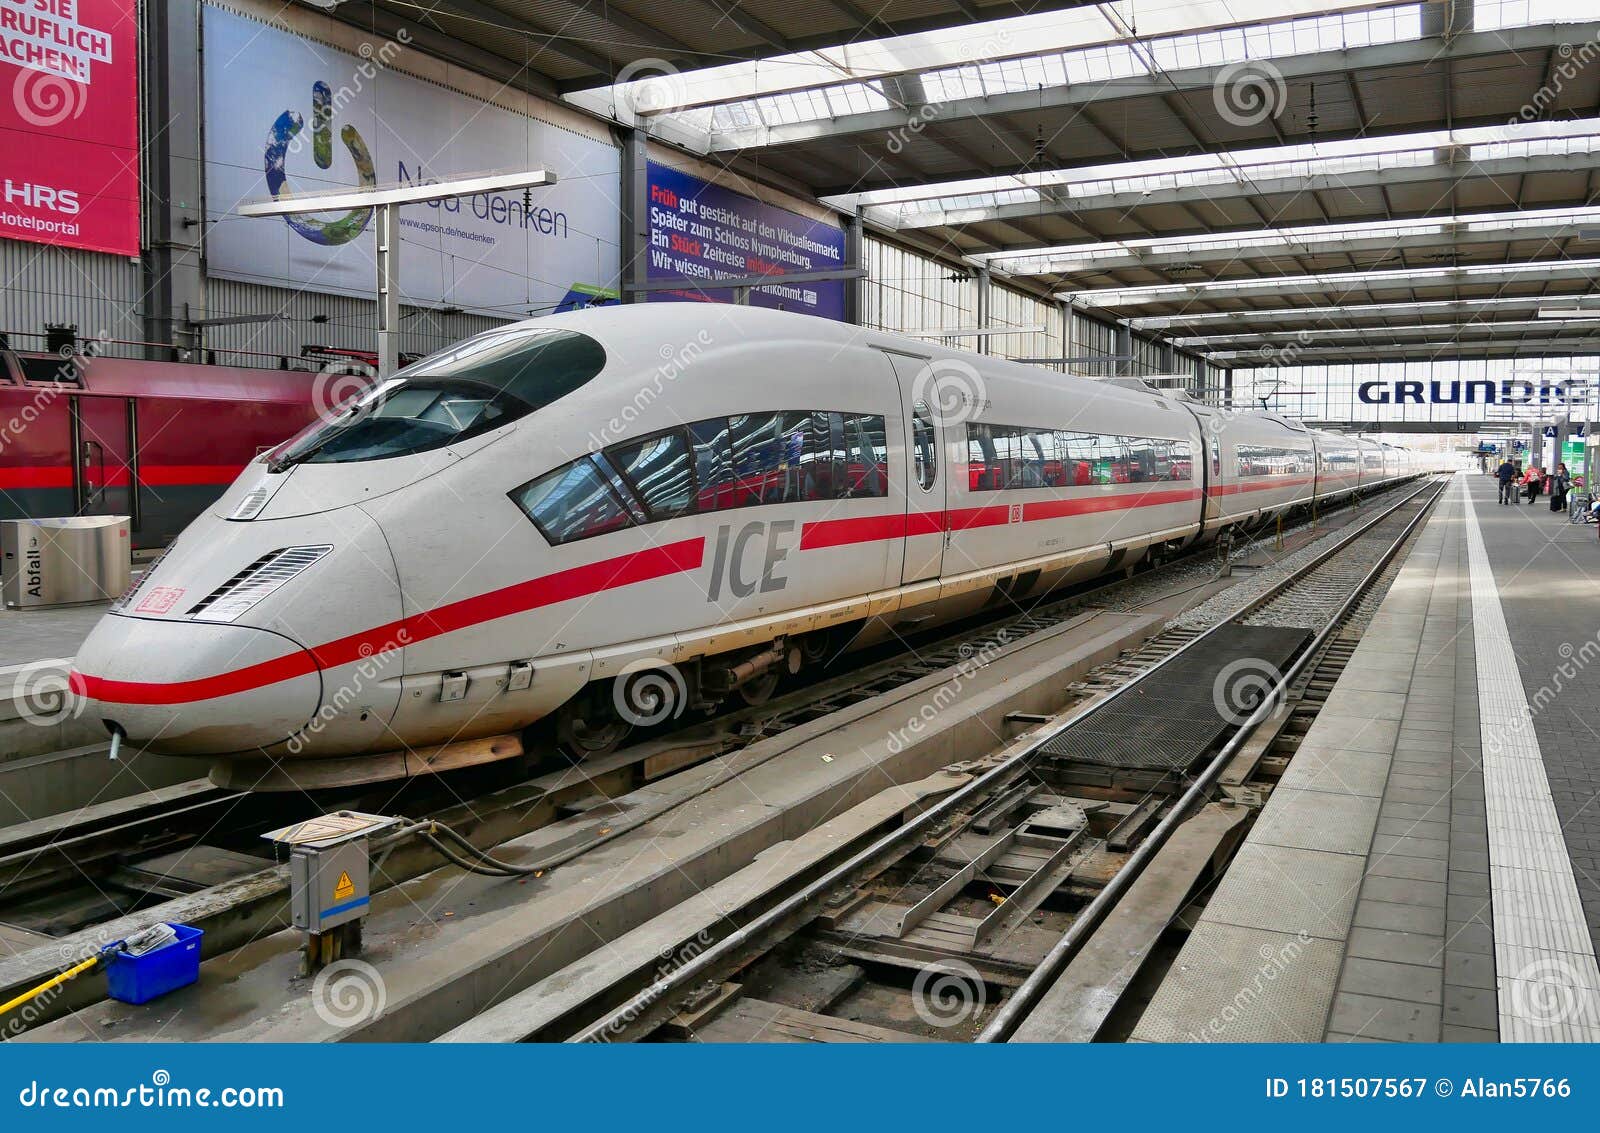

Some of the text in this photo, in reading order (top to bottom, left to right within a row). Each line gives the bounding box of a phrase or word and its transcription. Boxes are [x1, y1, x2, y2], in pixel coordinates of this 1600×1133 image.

[1, 6, 107, 57] RUFLICH
[4, 179, 80, 214] HRS
[472, 191, 568, 239] denken
[0, 211, 80, 236] Hotelportal
[651, 185, 841, 260] Früh gut gestärkt auf den Viktualienmarkt.
[651, 207, 813, 271] Später zum Schloss Nymphenburg.
[651, 229, 669, 249] Ein
[671, 234, 701, 257] Stück
[703, 242, 745, 269] Zeitreise
[651, 249, 673, 271] Wir
[1358, 380, 1587, 403] GRUNDIG
[1546, 426, 1555, 436] A
[27, 550, 41, 597] Abfall
[707, 519, 796, 603] ICE
